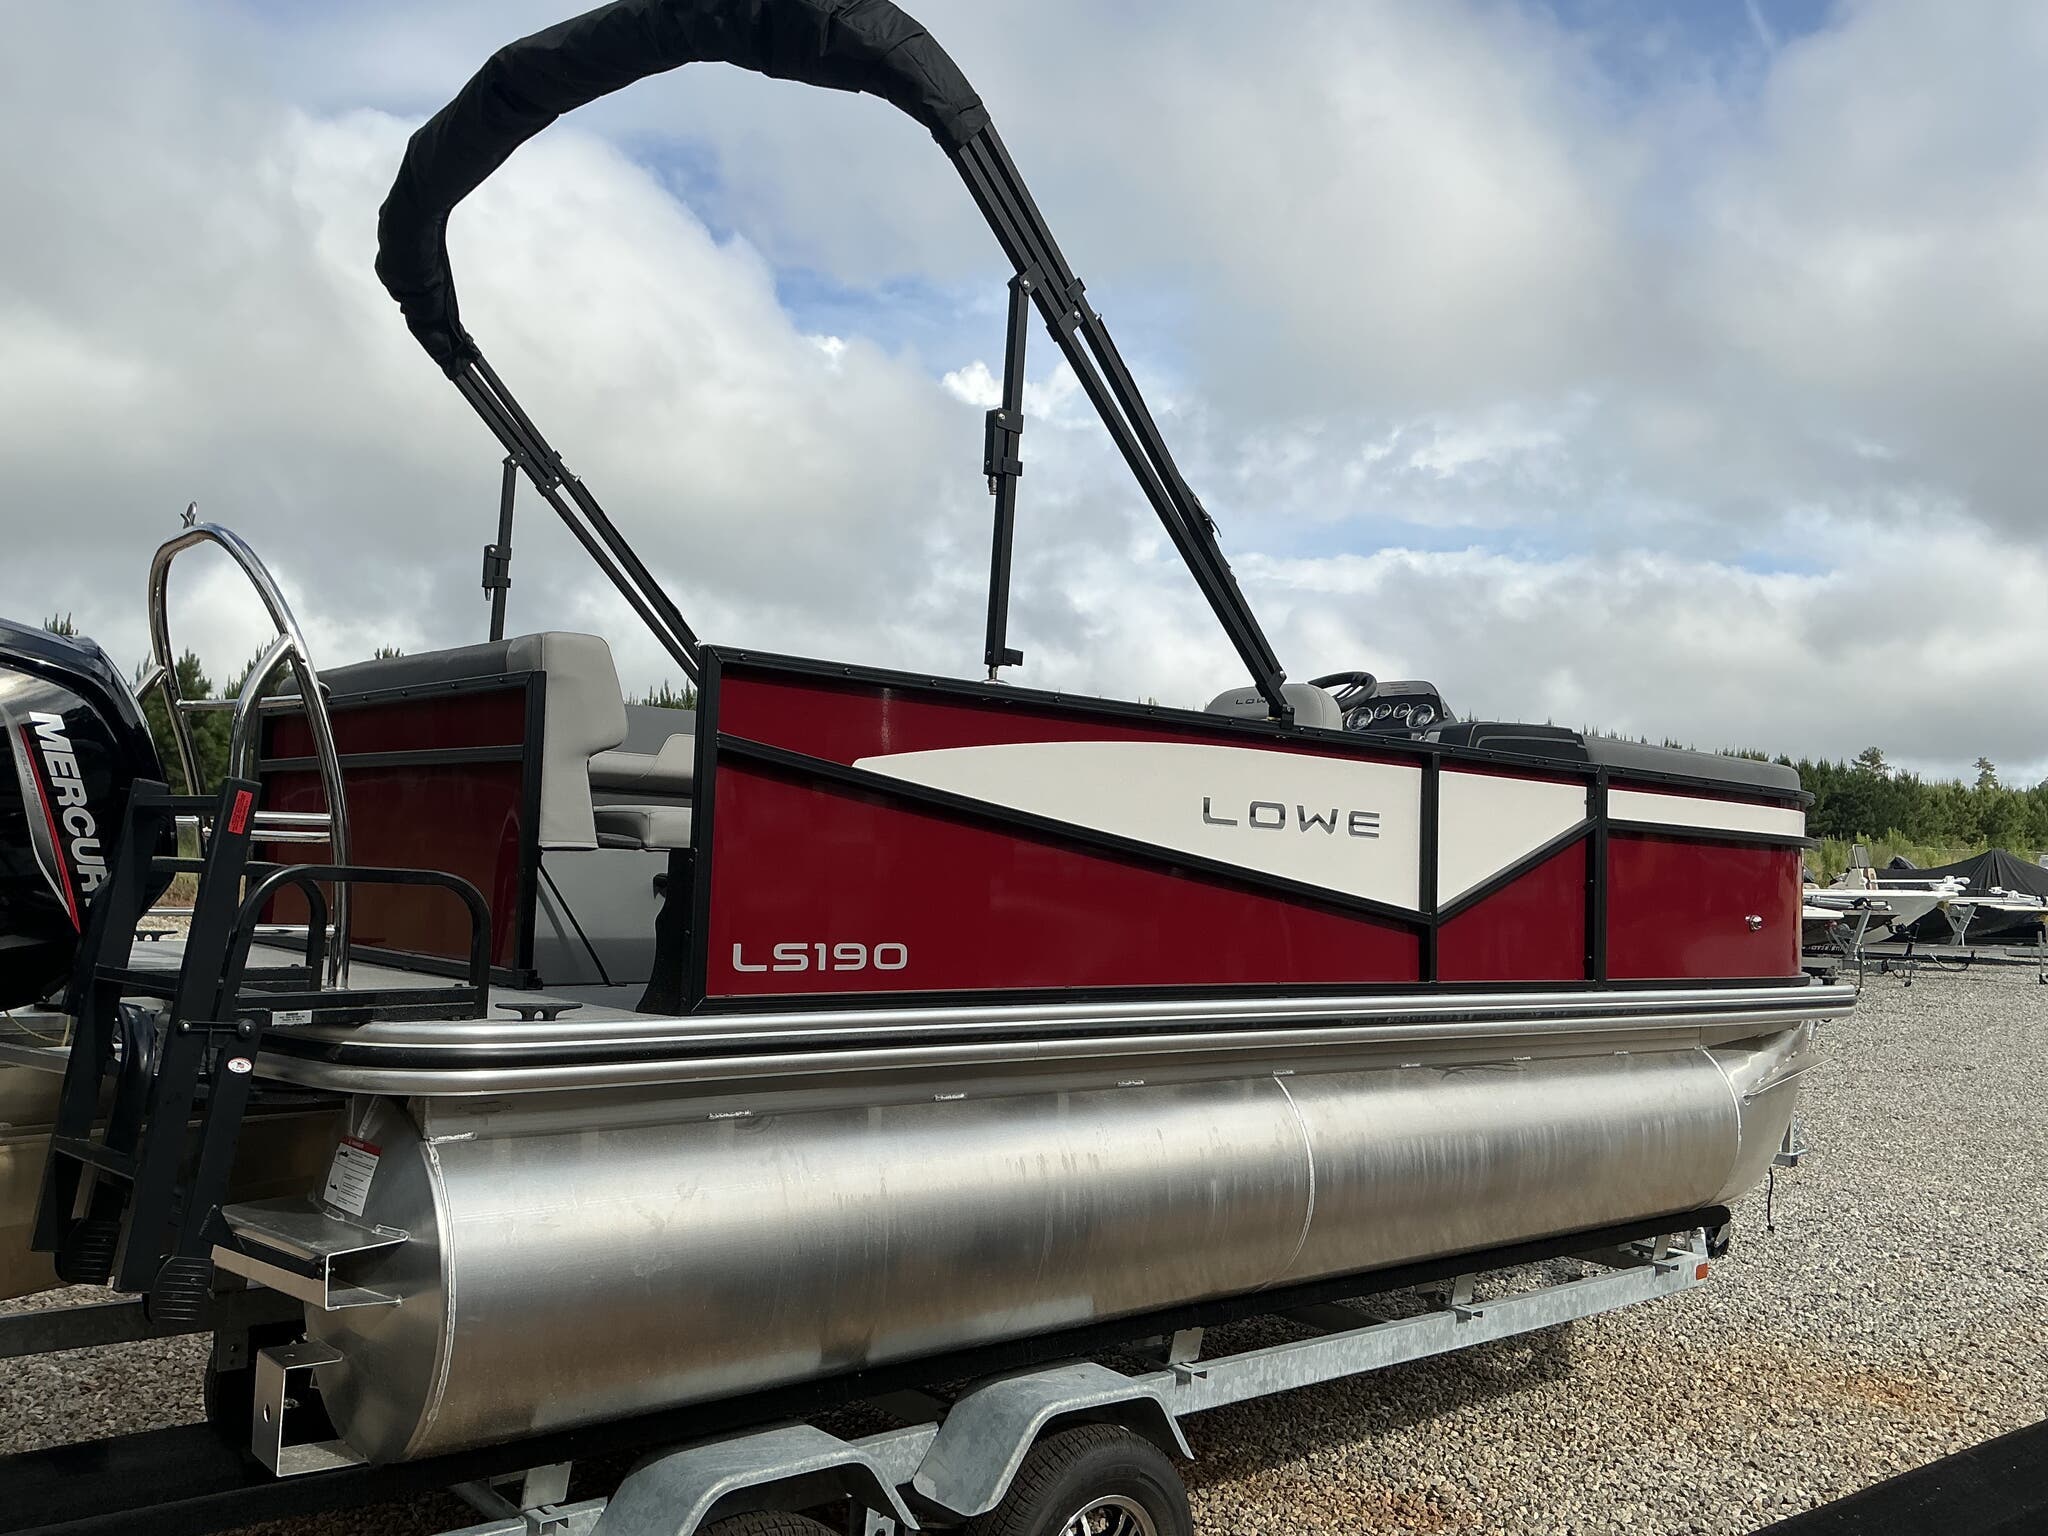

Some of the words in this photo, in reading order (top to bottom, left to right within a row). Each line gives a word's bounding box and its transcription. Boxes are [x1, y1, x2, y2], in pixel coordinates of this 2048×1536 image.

[1235, 697, 1267, 706] LOW
[28, 711, 108, 907] MERCUR
[1202, 796, 1381, 839] LOWE
[732, 942, 908, 972] LS190
